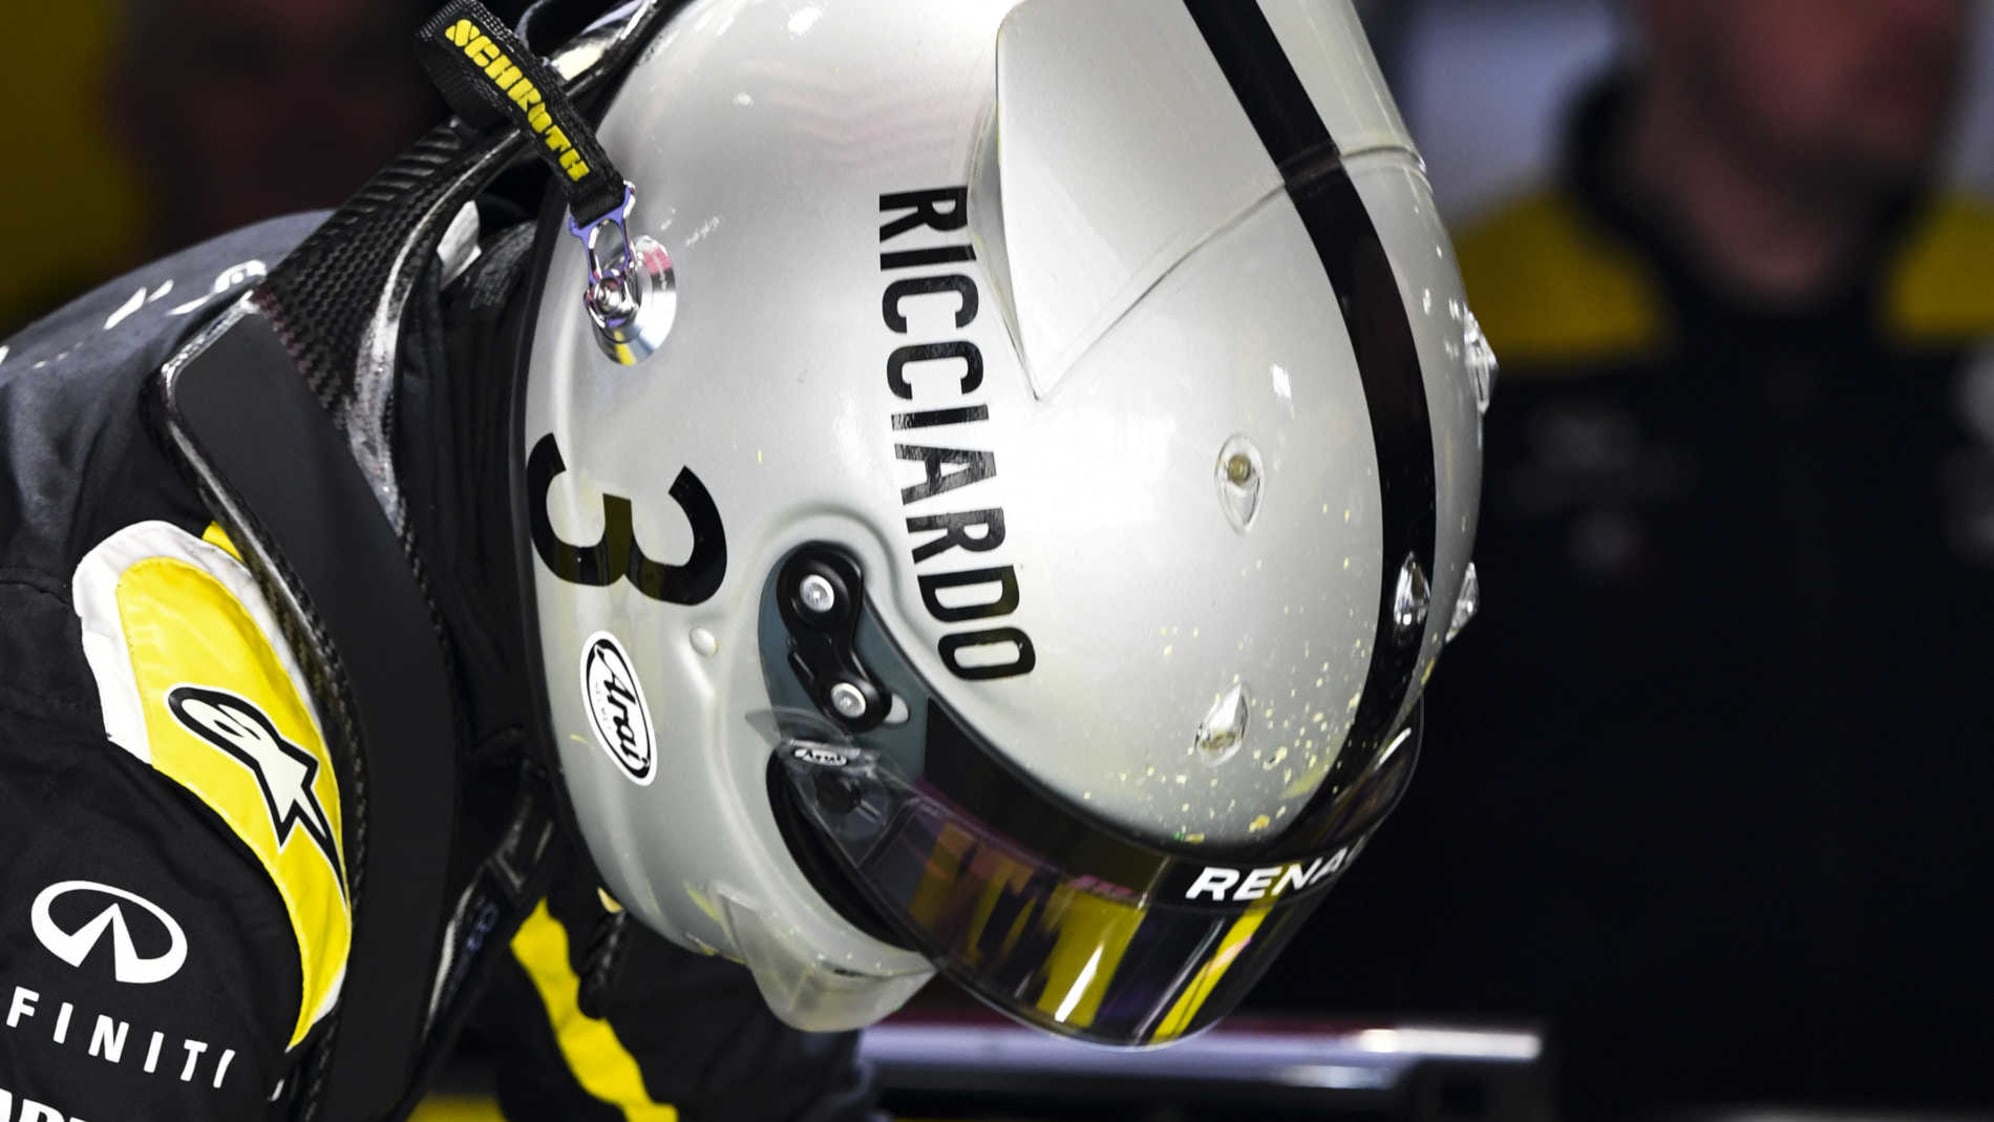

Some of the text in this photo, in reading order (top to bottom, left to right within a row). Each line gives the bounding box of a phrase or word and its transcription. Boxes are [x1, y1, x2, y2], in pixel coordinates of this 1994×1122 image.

[445, 19, 590, 182] SCHROTH
[879, 185, 1036, 681] RICCIARDO
[526, 432, 727, 606] 3
[595, 646, 649, 765] Arai
[6, 985, 236, 1089] FINITI
